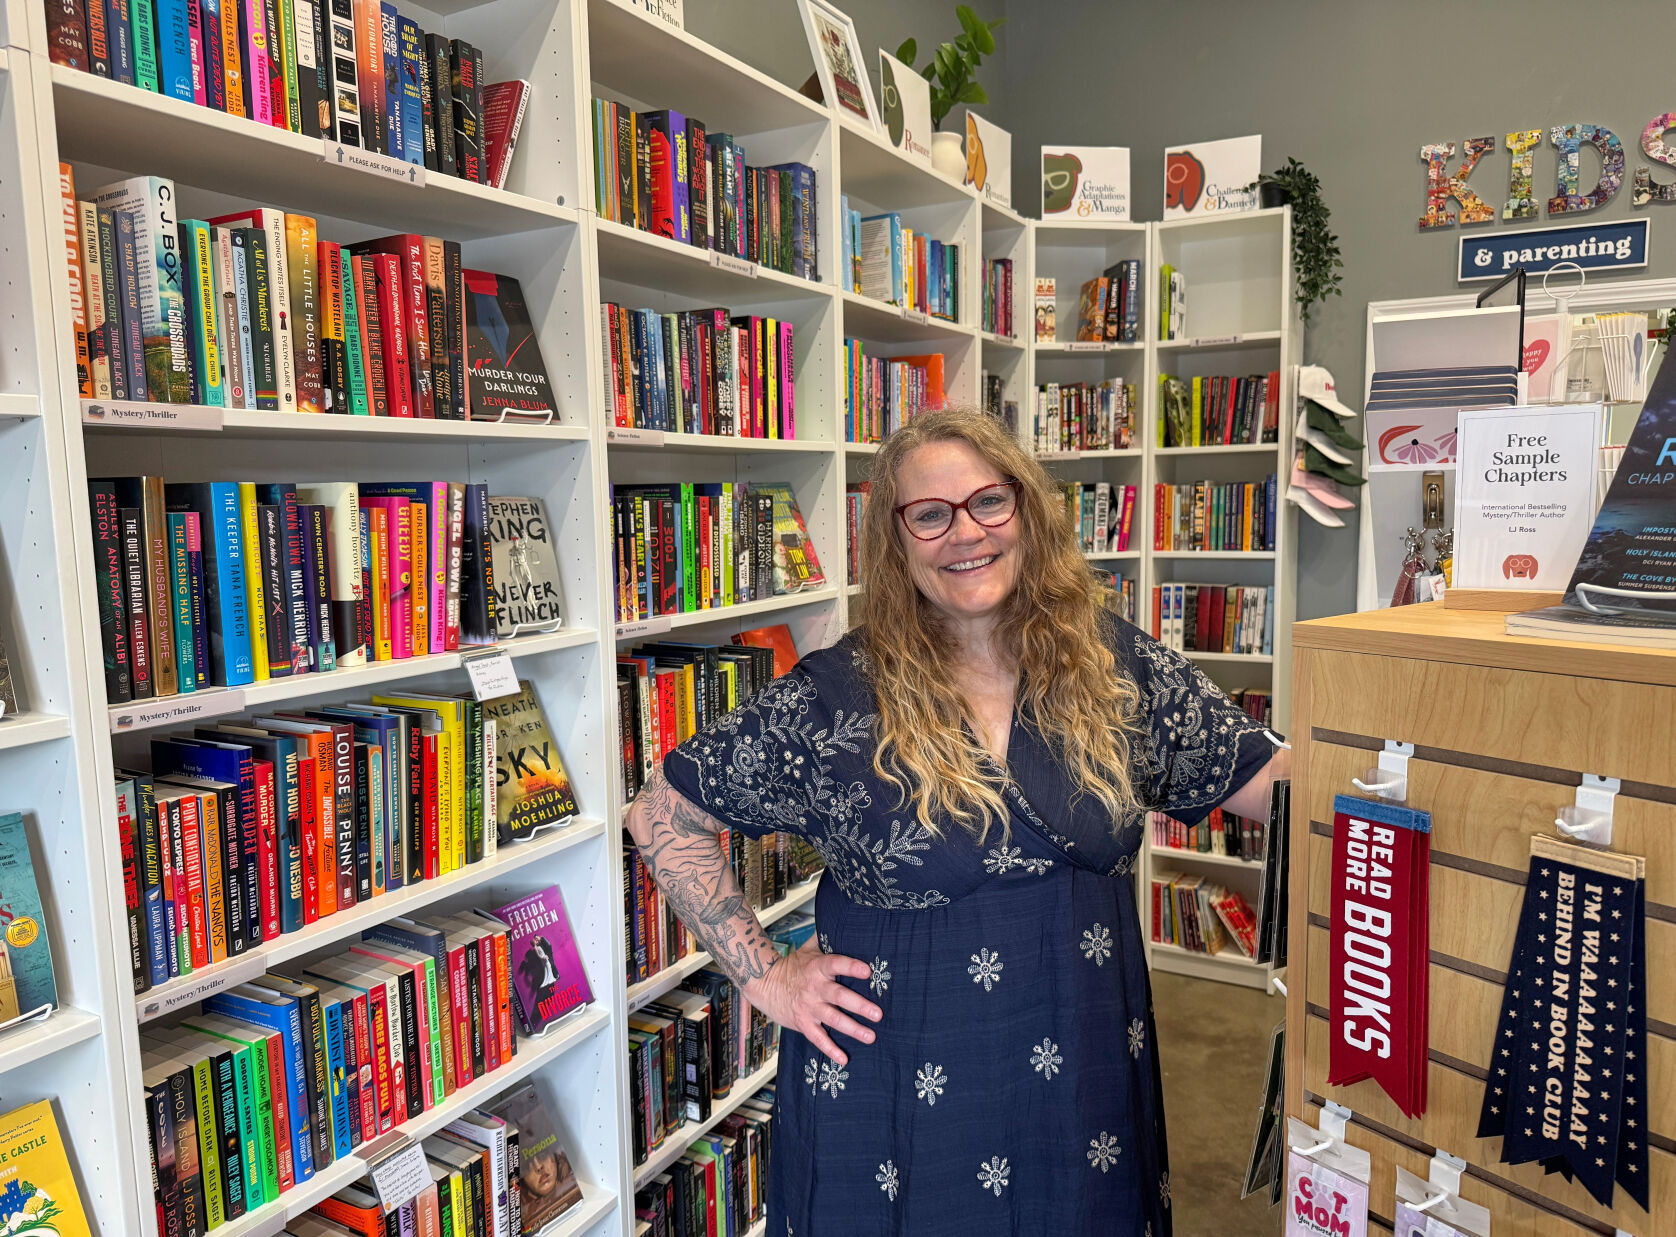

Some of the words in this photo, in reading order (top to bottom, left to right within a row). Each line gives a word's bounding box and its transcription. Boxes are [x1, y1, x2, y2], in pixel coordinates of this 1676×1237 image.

[58, 37, 83, 50] COBB
[60, 25, 80, 37] MAY
[172, 7, 186, 56] FRENCH
[381, 12, 392, 54] HOUSE
[189, 38, 198, 61] Fever
[191, 62, 201, 91] Beach
[255, 51, 266, 94] Kirsten
[258, 95, 268, 121] King
[905, 129, 930, 158] Romance
[349, 156, 368, 168] PLEASE
[369, 160, 380, 170] ASK
[381, 165, 392, 173] FOR
[392, 168, 406, 177] HELP
[1419, 112, 1676, 228] KIDS
[158, 185, 171, 207] C.
[1079, 189, 1125, 201] Adaptations
[1083, 181, 1116, 193] Graphic
[1077, 200, 1091, 217] &
[1091, 200, 1126, 215] Manga
[1204, 197, 1216, 210] &
[160, 212, 172, 230] J.
[301, 228, 309, 250] ALL
[1474, 248, 1493, 267] &
[1502, 236, 1632, 270] parenting
[162, 237, 178, 285] BOX
[428, 243, 440, 282] Davis
[1129, 262, 1137, 291] MARCH
[199, 233, 207, 265] EVERYONE
[206, 326, 214, 343] DIES
[303, 270, 313, 309] LITTLE
[305, 313, 316, 362] HOUSES
[431, 291, 445, 359] Patterson
[168, 309, 186, 373] CROSSROADS
[468, 368, 514, 380] MURDER
[515, 373, 545, 385] YOUR
[484, 381, 538, 396] DARLINGS
[111, 408, 178, 420] Mystery/Thriller
[482, 396, 517, 408] JENNA
[520, 400, 549, 411] BLUM
[1507, 433, 1547, 447] Free
[1493, 449, 1560, 468] Sample
[1484, 468, 1567, 486] Chapters
[1627, 472, 1675, 485] CHAP
[96, 493, 109, 540] ELSTON
[108, 493, 119, 539] ASHLEY
[224, 492, 235, 513] THE
[285, 492, 297, 530] CLOWN
[452, 489, 463, 541] ANGEL
[489, 502, 540, 516] EPHEN
[1482, 511, 1537, 519] Mystery/Thriller
[154, 539, 163, 557] MY
[175, 525, 185, 544] THE
[227, 517, 238, 559] KEEPER
[398, 506, 410, 561] GREEDY
[664, 527, 674, 562] WOOL
[758, 524, 766, 567] GIDEON
[287, 535, 300, 565] TOWN
[636, 533, 645, 566] HEART
[789, 549, 806, 563] TOM
[177, 548, 188, 595] MISSING
[231, 563, 240, 590] TANA
[290, 570, 304, 597] MICK
[451, 546, 461, 593] DOWN
[796, 565, 810, 578] LIN
[1665, 575, 1676, 583] BY
[155, 559, 168, 629] HUSBAND'S
[494, 581, 558, 605] NEVER
[1644, 583, 1675, 591] SUSPENSE
[108, 548, 121, 608] ANATOMY
[115, 633, 127, 664] ALIBI
[180, 600, 190, 626] HALF
[233, 595, 245, 637] FRENCH
[497, 601, 560, 627] FLINCH
[292, 601, 307, 643] HERRON
[160, 630, 170, 659] WIFE
[139, 706, 202, 722] Mystery/Thriller
[487, 698, 538, 719] NEATH
[411, 727, 421, 762] Ruby
[285, 752, 297, 788] WOLF
[335, 733, 350, 795] LOUISE
[411, 764, 421, 795] Falls
[496, 742, 553, 787] SKY
[286, 790, 299, 821] HOUR
[511, 800, 574, 831] MOEHLING
[515, 790, 562, 814] JOSHUA
[172, 807, 180, 834] TOKYO
[119, 814, 134, 861] BONE
[288, 845, 300, 859] JO
[338, 819, 353, 877] PENNY
[174, 837, 185, 877] EXPRESS
[1346, 818, 1370, 896] MORE
[1369, 826, 1394, 901] READ
[124, 863, 139, 910] THIEF
[508, 900, 546, 926] FREIDA
[1554, 870, 1576, 965] BEHIND
[1583, 882, 1603, 923] I'M
[511, 909, 559, 942] cFADDEN
[164, 978, 225, 1006] Mystery/Thriller
[1343, 899, 1393, 1060] BOOKS
[1552, 970, 1570, 1001] IN
[538, 984, 582, 1020] DIVORCE
[1548, 1003, 1568, 1072] BOOK
[173, 1092, 187, 1128] HOLY
[202, 1095, 210, 1128] BEFORE
[1541, 1077, 1563, 1141] CLUB
[10, 1135, 47, 1158] CASTLE
[178, 1130, 190, 1171] ISLAND
[205, 1129, 213, 1152] DARK
[521, 1134, 557, 1160] Persona
[210, 1195, 219, 1224] SAGER
[1295, 1195, 1350, 1237] MOM
